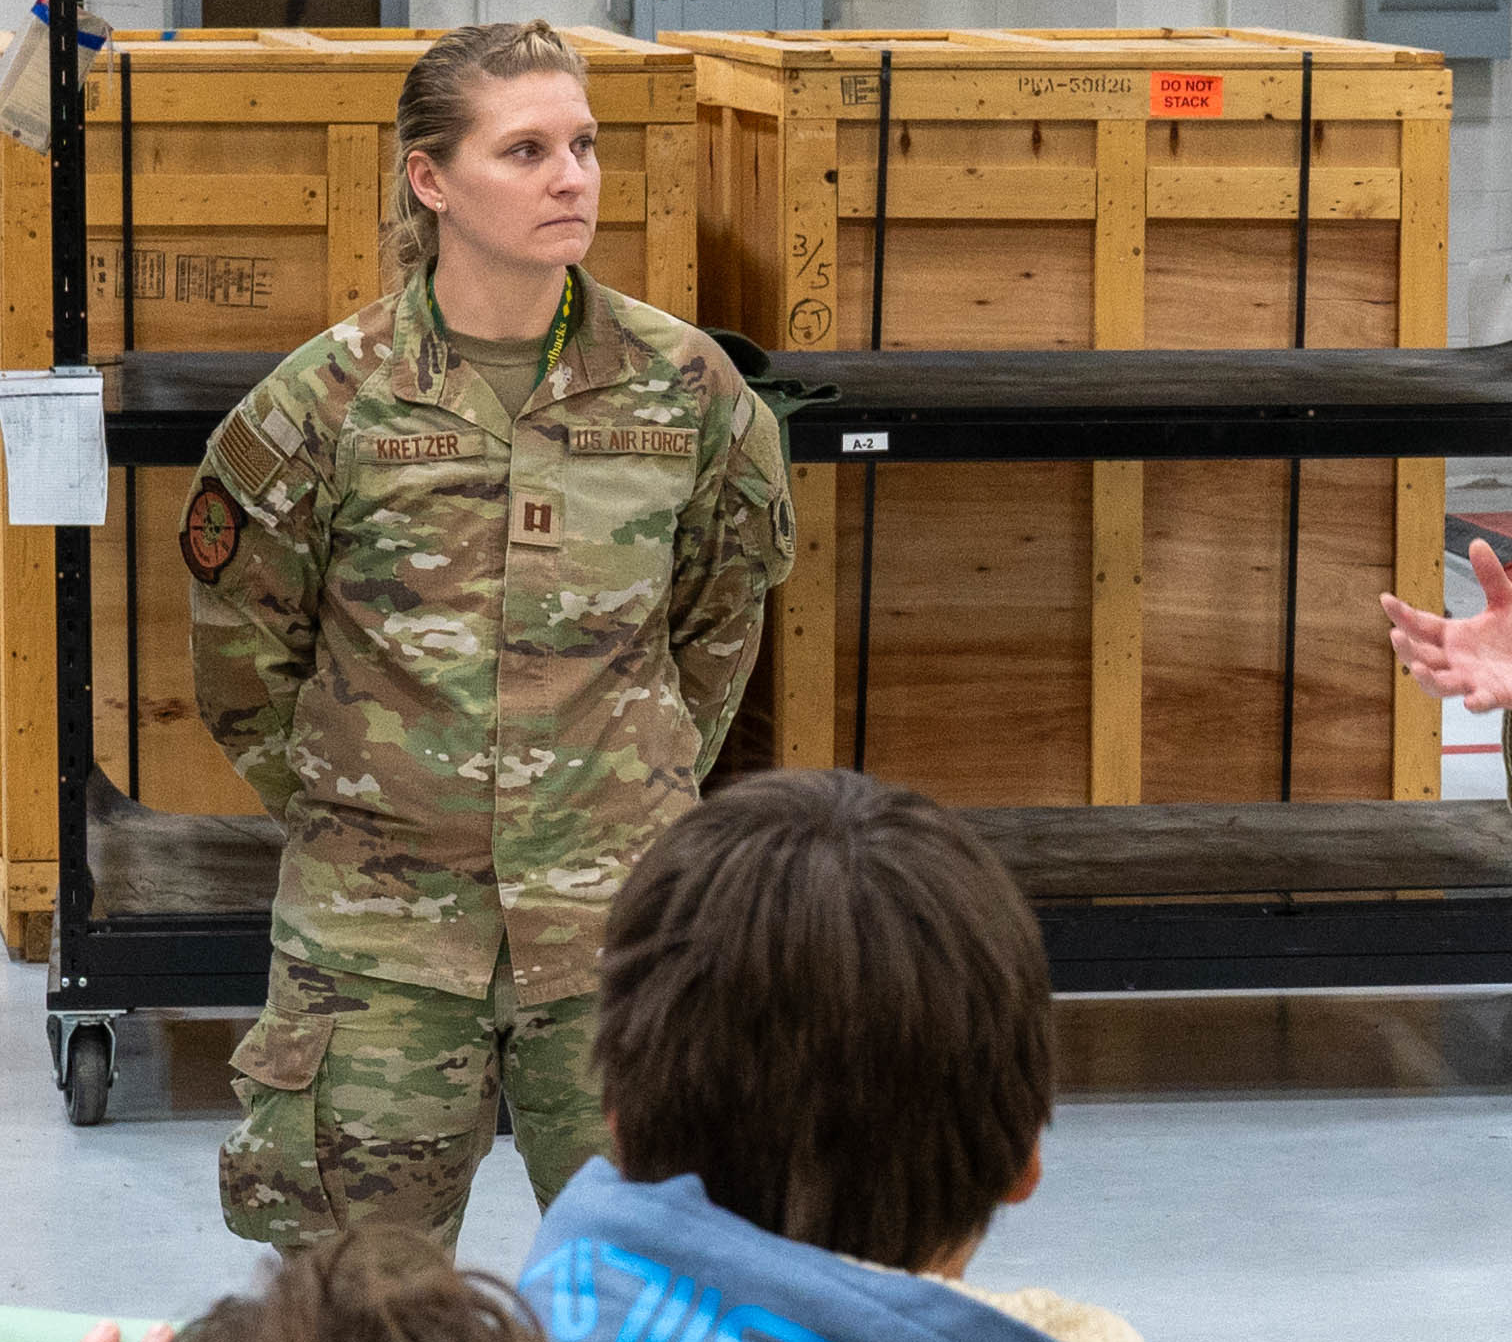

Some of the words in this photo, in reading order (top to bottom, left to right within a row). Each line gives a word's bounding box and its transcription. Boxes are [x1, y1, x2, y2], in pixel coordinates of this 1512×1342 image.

[1161, 80, 1181, 92] DO
[1185, 80, 1214, 92] NOT
[1164, 96, 1209, 108] STACK
[377, 435, 460, 459] KRETZER
[610, 433, 638, 451] AIR
[641, 433, 693, 454] FORCE
[852, 438, 875, 450] A-2
